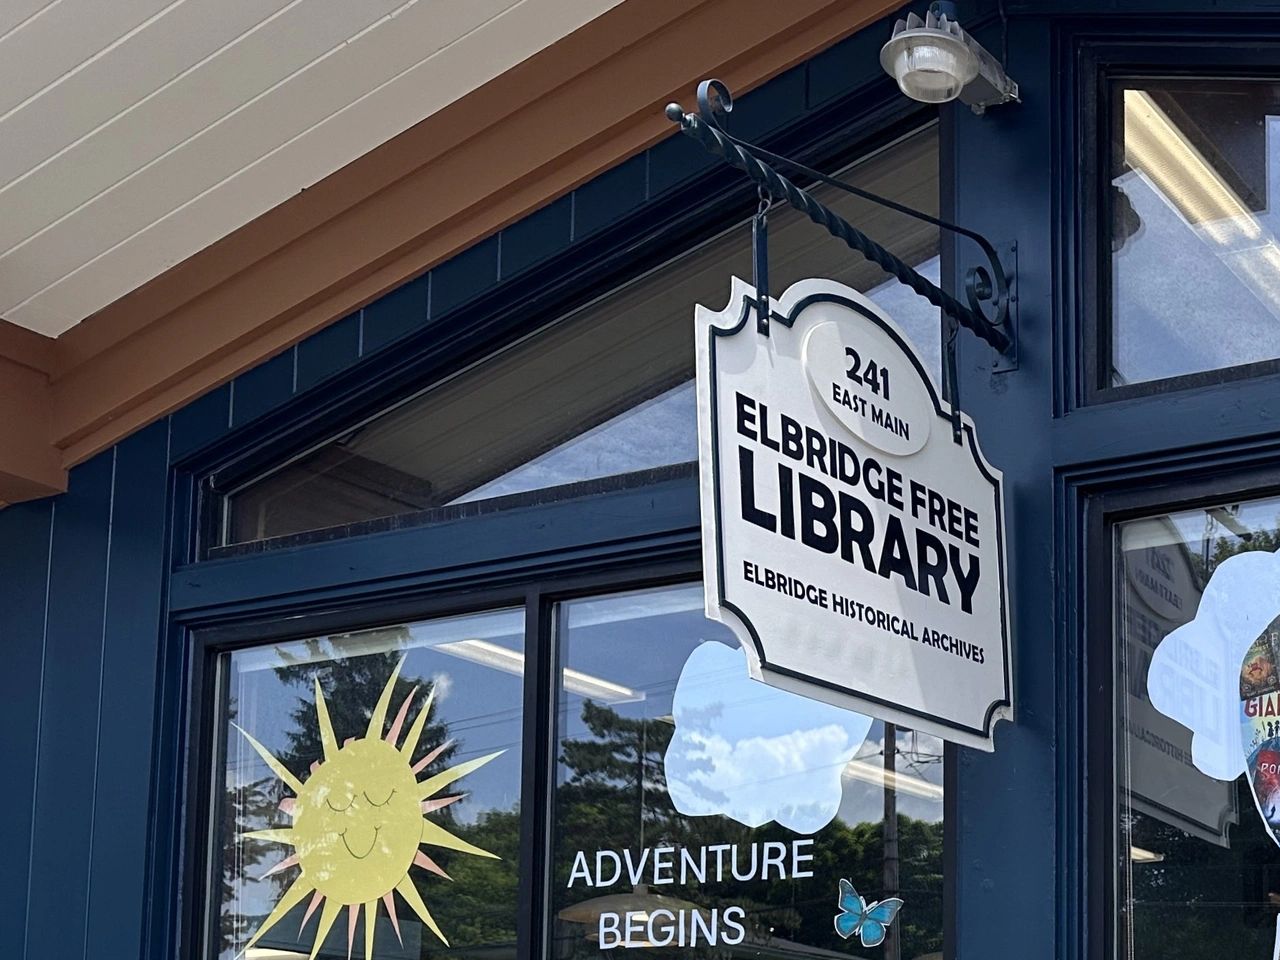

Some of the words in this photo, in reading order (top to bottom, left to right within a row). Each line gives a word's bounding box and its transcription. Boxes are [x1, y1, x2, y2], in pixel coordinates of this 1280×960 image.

[845, 346, 891, 401] 241
[832, 384, 868, 418] EAST
[871, 404, 910, 441] MAIN
[735, 391, 904, 511] ELBRIDGE
[909, 479, 980, 549] FREE
[738, 445, 981, 615] LIBRARY
[743, 561, 828, 608] ELBRIDGE
[832, 593, 919, 641] HISTORICAL
[922, 627, 985, 665] ARCHIVES
[567, 839, 815, 888] ADVENTURE
[599, 906, 746, 949] BEGINS
